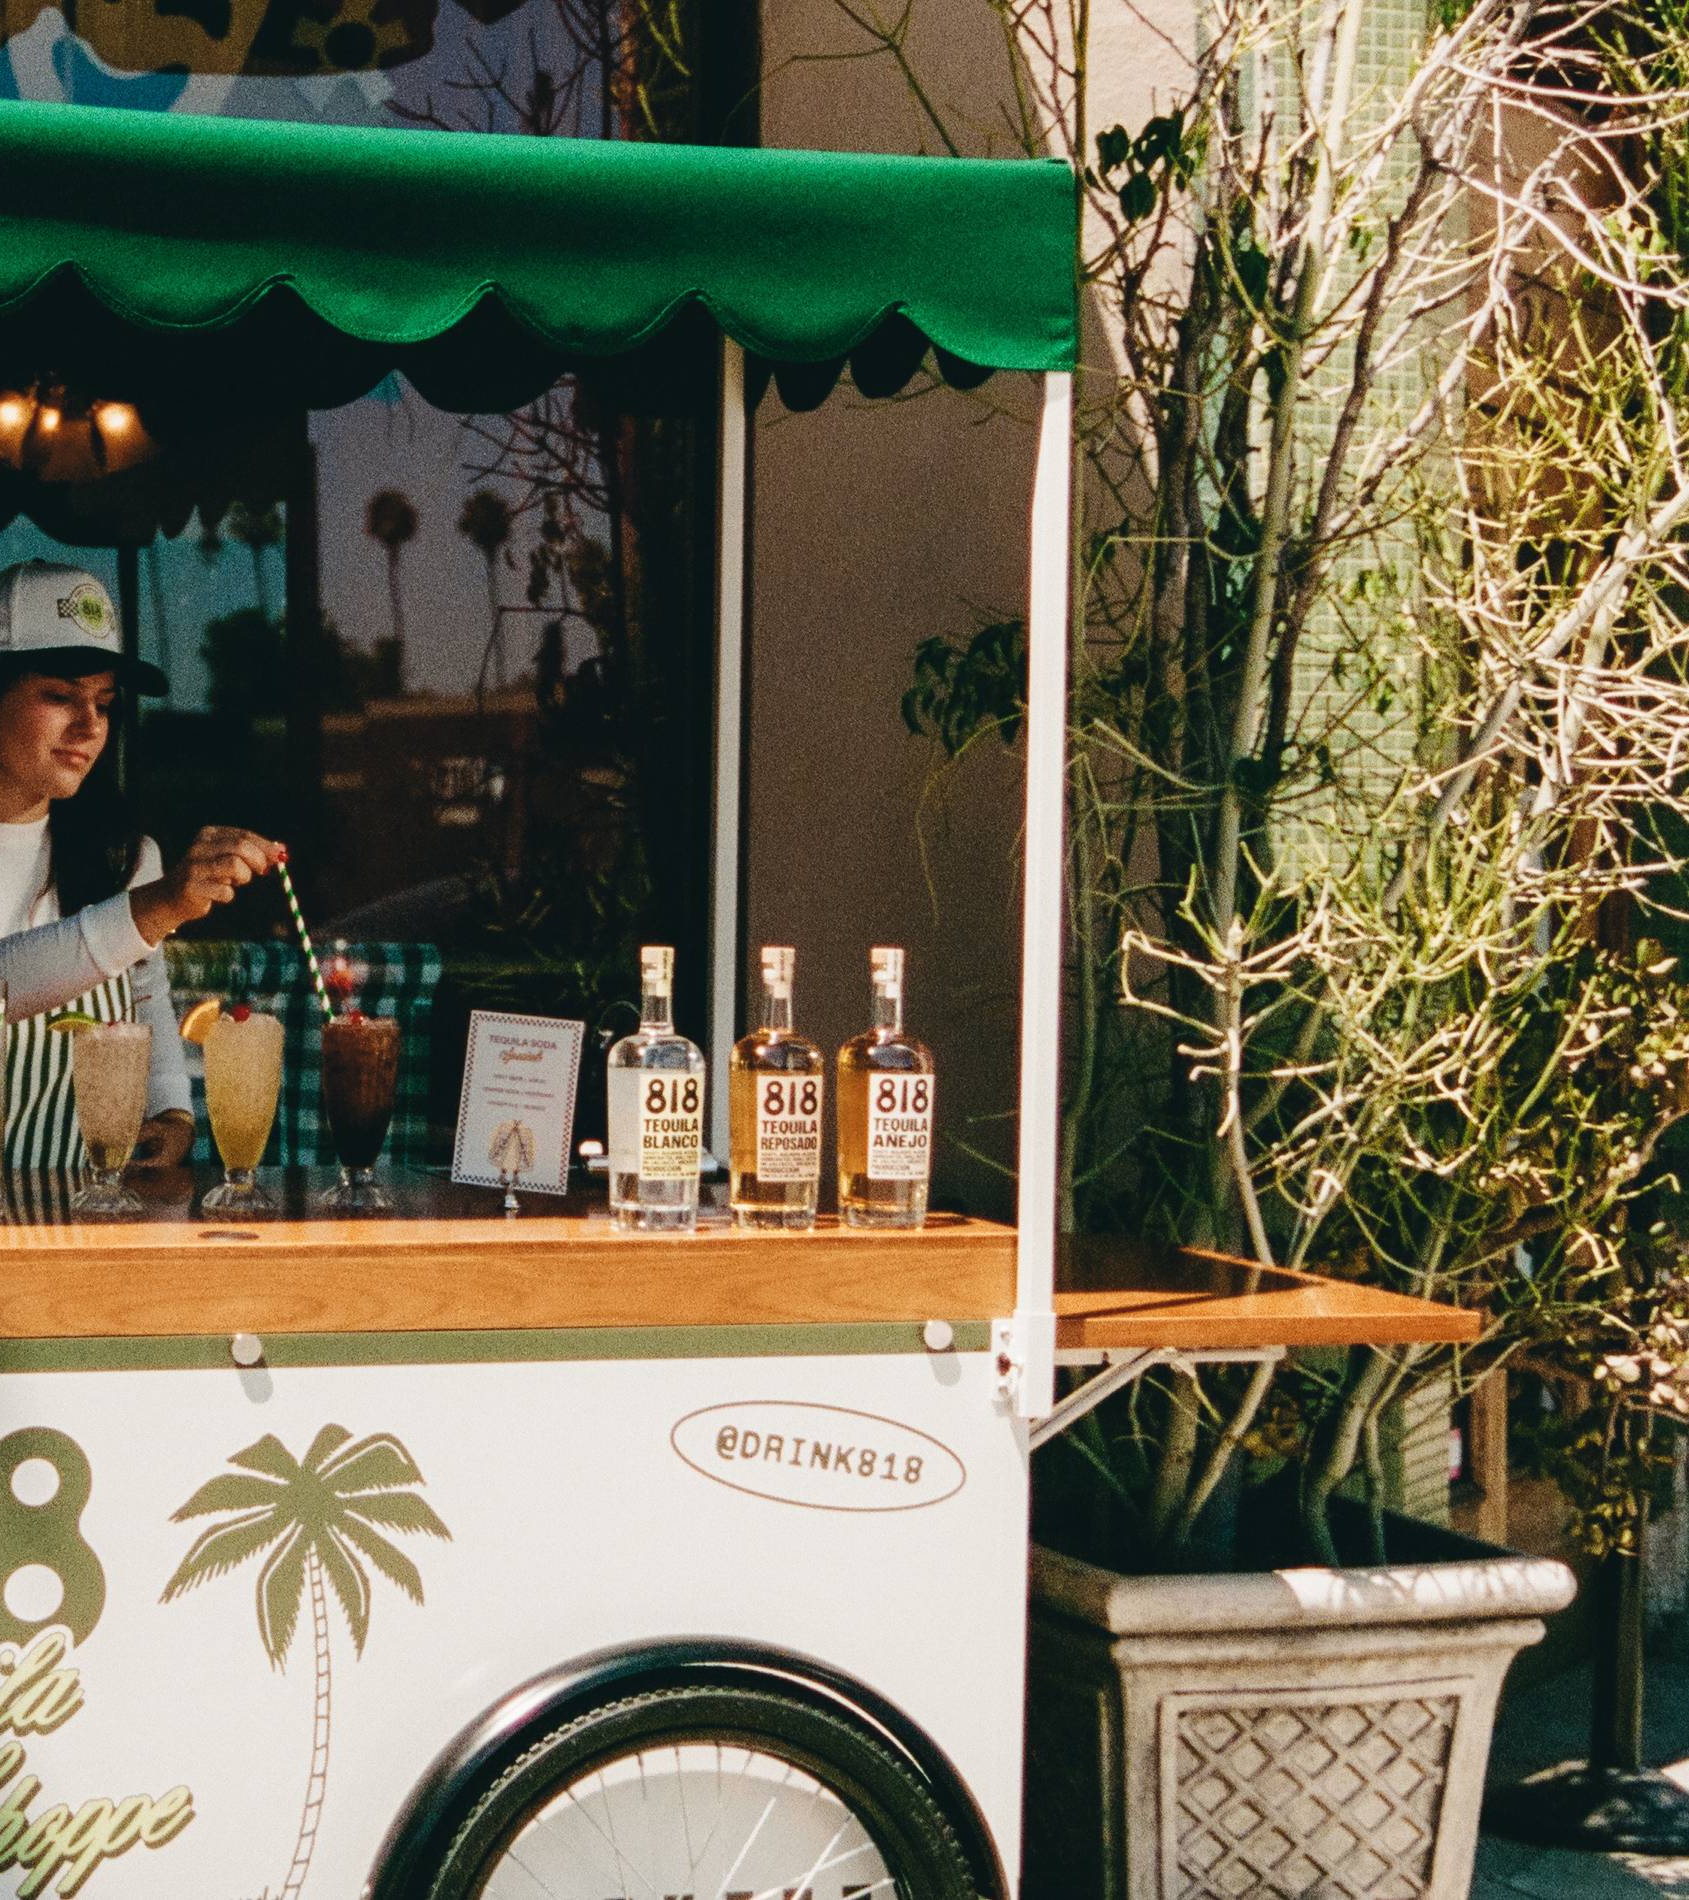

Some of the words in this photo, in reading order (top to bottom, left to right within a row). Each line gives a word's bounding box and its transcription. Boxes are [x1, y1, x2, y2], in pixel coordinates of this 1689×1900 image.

[645, 1078, 699, 1115] 818
[764, 1080, 818, 1116] 818
[876, 1078, 929, 1114] 818
[644, 1118, 699, 1133] TEQUILA
[762, 1120, 818, 1135] TEQUILA
[874, 1117, 928, 1133] TEQUILA
[643, 1134, 699, 1150] BLANCO
[760, 1136, 818, 1151] REPOSADO
[715, 1424, 925, 1485] @DRINK818
